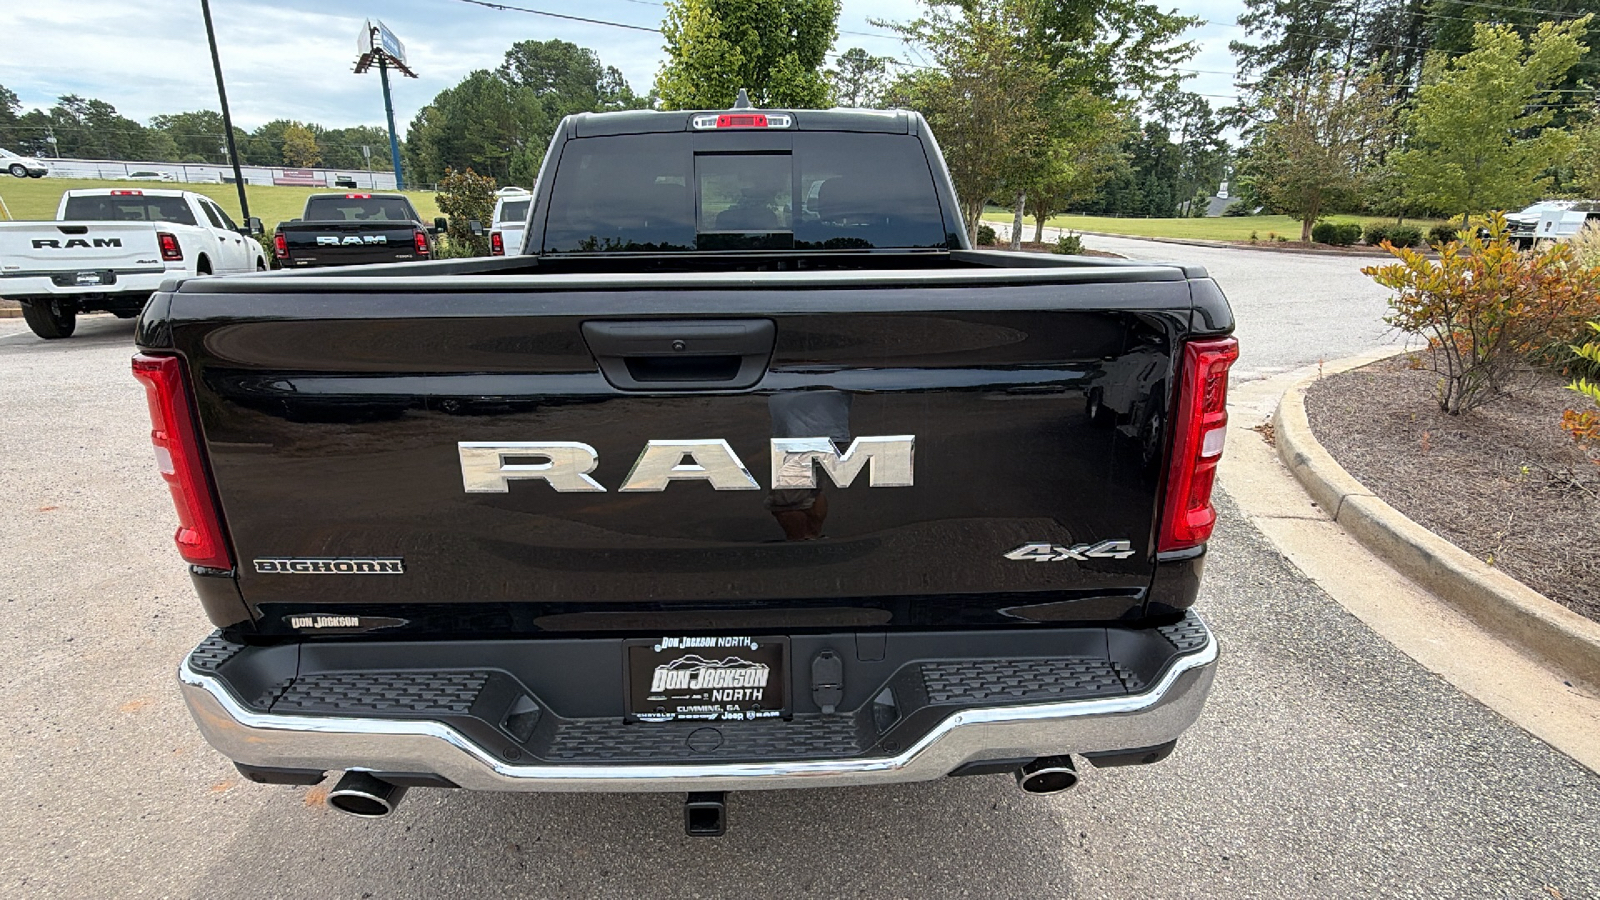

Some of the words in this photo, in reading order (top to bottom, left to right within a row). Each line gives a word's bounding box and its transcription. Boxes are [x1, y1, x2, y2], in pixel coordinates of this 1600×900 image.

[31, 238, 123, 248] RAM
[316, 235, 388, 246] RAM
[457, 434, 916, 493] RAM
[1003, 538, 1136, 562] 4x4
[252, 558, 405, 574] BIGHORN
[717, 636, 751, 648] NORTH
[711, 688, 764, 702] NORTH
[676, 704, 724, 713] CUMMING,
[726, 704, 741, 712] GA
[721, 711, 744, 721] Jeep
